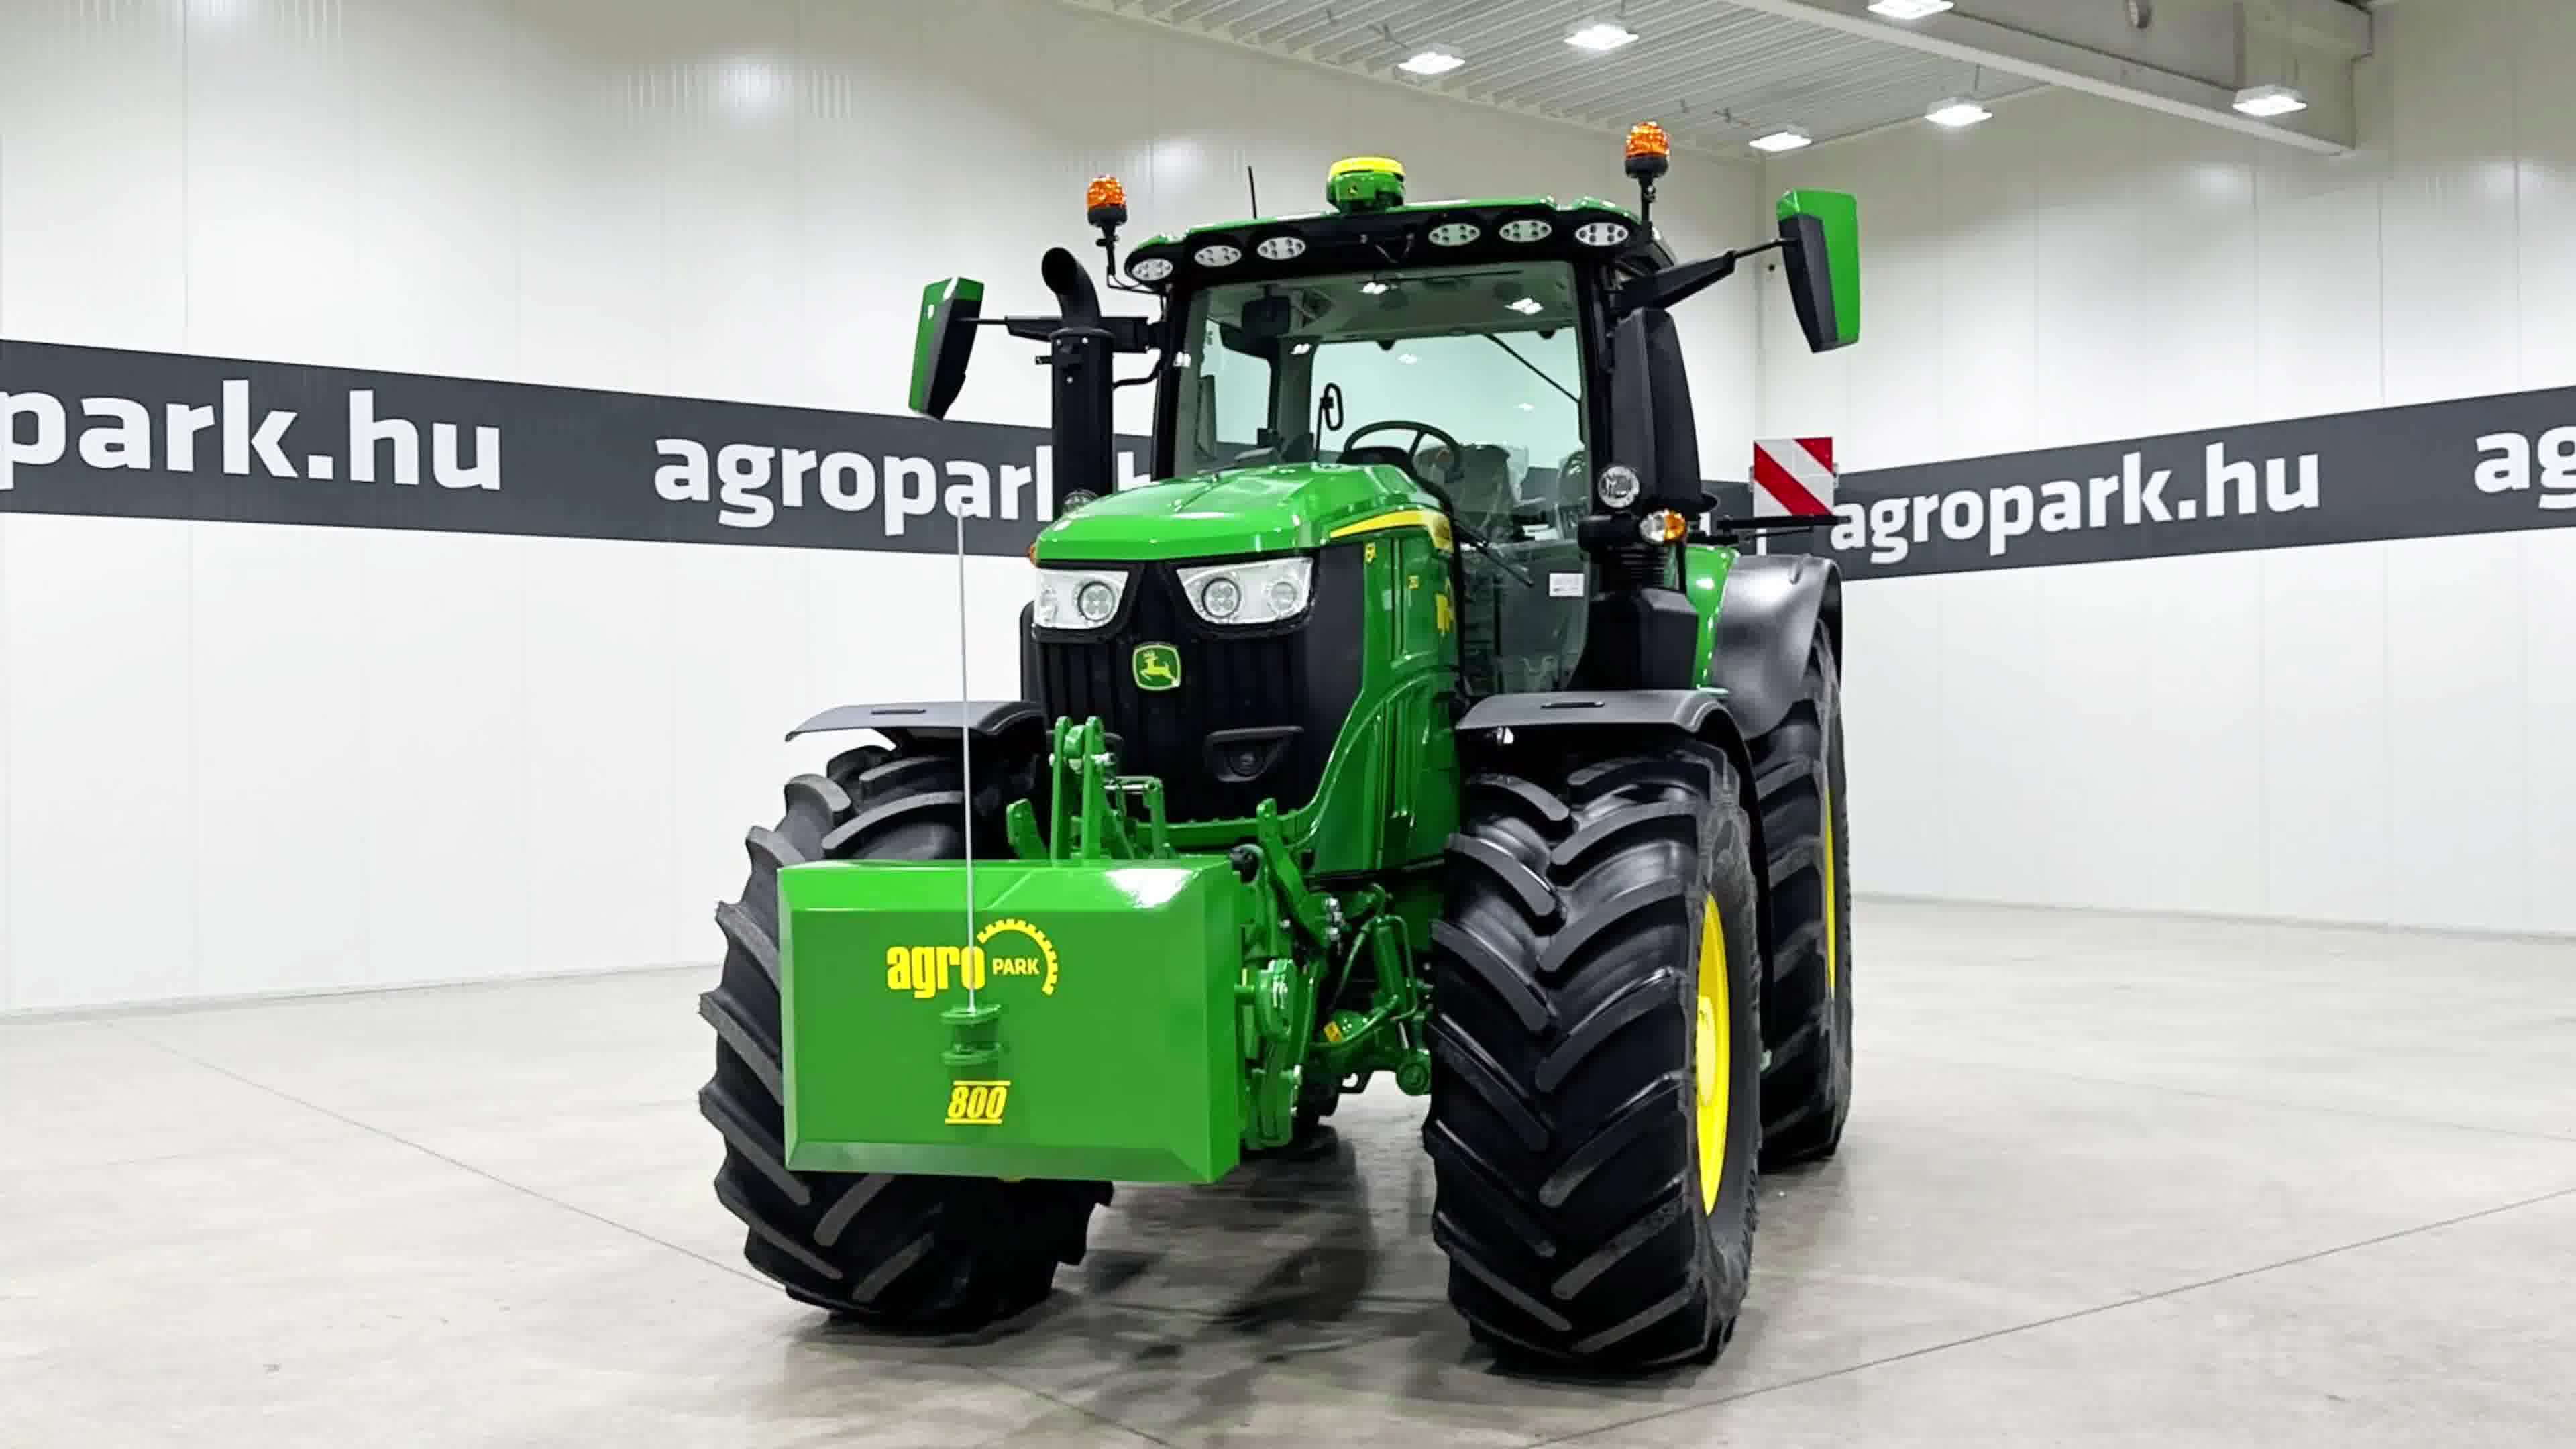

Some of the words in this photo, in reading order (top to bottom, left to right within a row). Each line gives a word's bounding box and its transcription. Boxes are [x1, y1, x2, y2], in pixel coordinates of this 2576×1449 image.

[1830, 442, 2320, 564] agropark.hu
[886, 945, 985, 998] agro
[992, 958, 1040, 975] PARK
[947, 1085, 1008, 1120] 800
